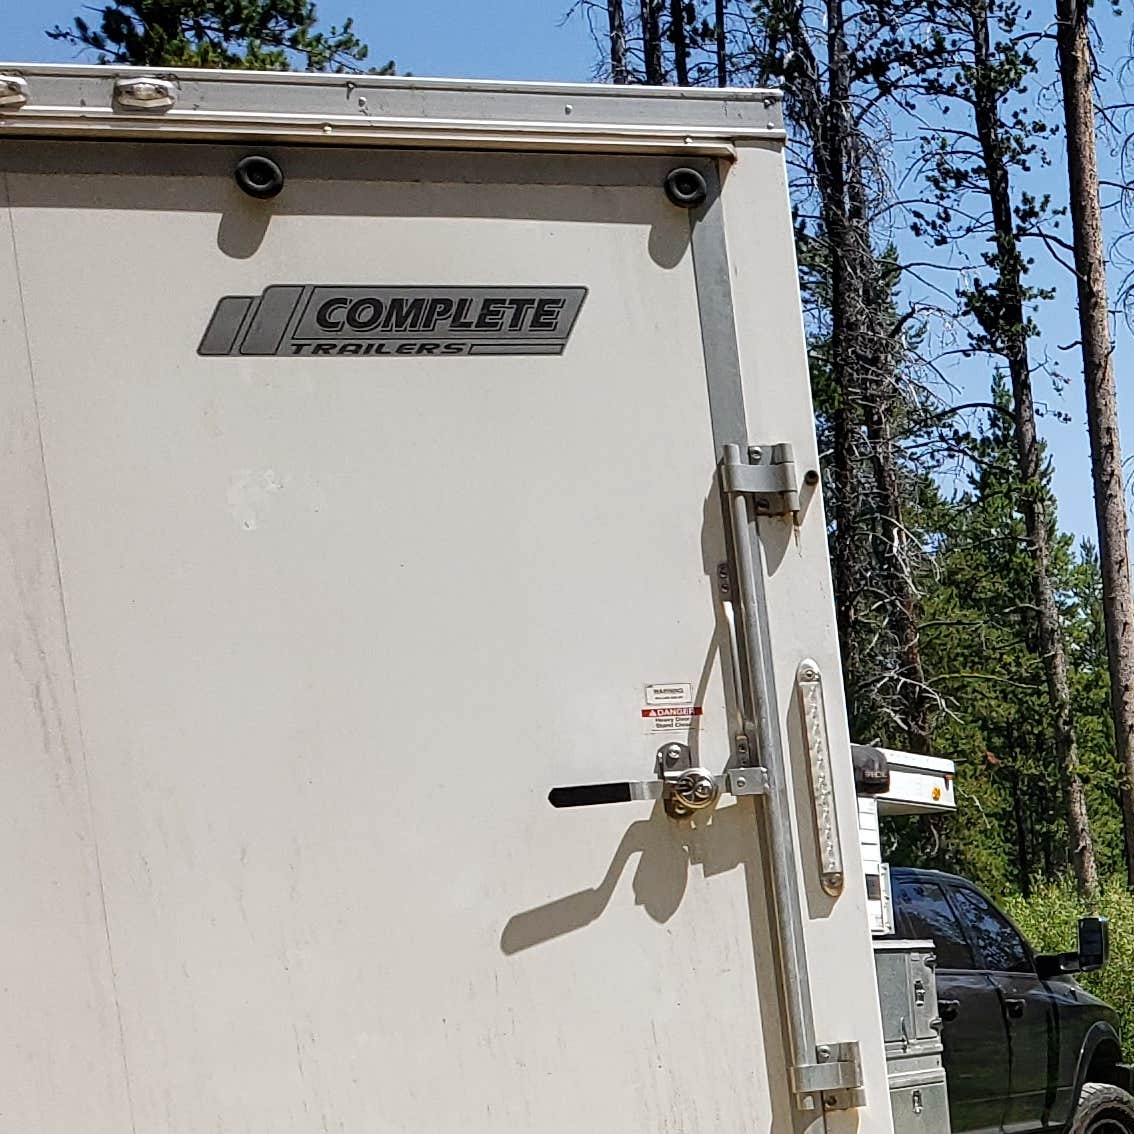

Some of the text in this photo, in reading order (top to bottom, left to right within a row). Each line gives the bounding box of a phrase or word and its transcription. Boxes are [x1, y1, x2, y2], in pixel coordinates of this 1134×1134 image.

[316, 296, 566, 333] COMPLETE
[291, 342, 469, 356] TRAILERS
[657, 708, 695, 716] DANGER
